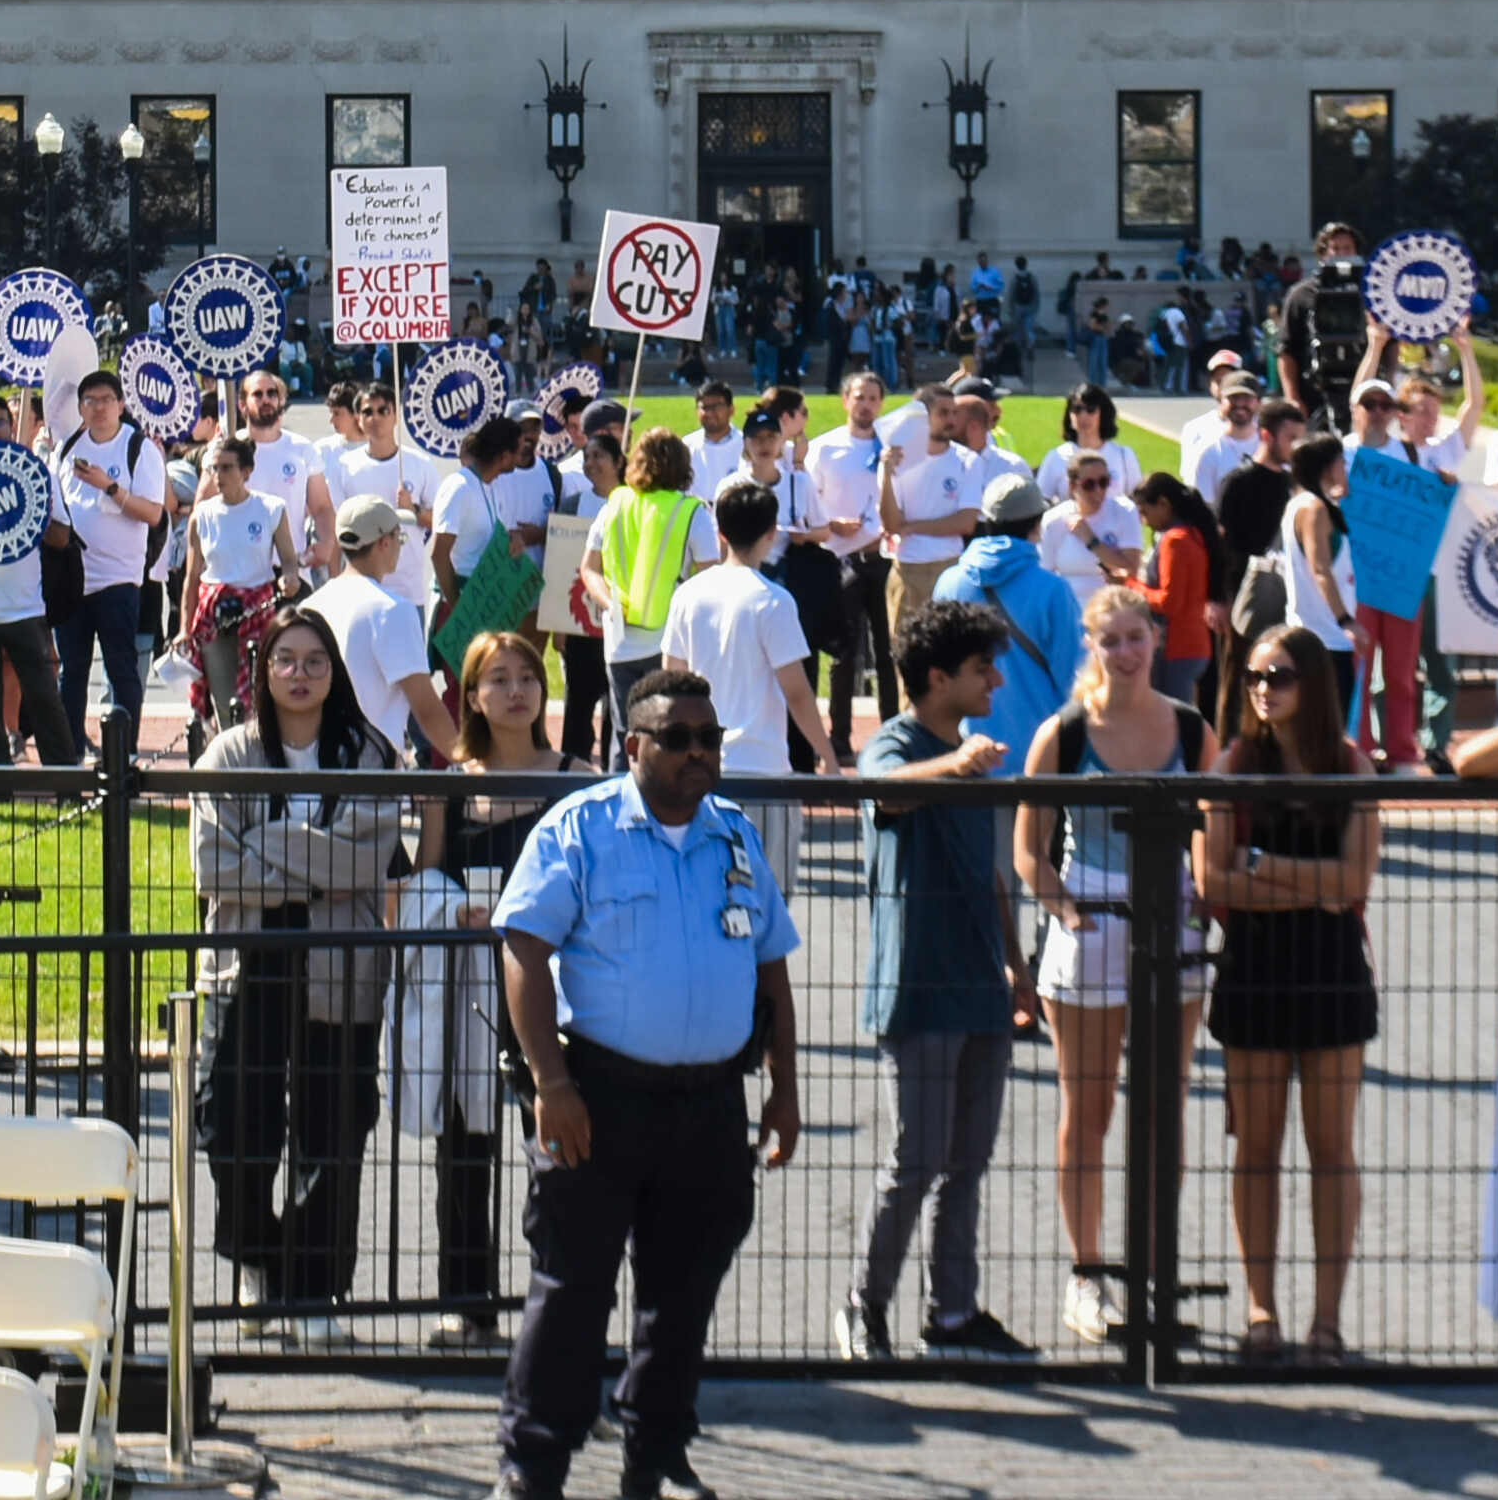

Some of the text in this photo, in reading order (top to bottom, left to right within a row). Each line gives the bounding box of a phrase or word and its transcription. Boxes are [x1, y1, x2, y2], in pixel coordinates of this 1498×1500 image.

[631, 240, 692, 278] PAY
[337, 262, 448, 294] EXCEPT
[341, 296, 359, 318] IF
[615, 280, 694, 318] CUTS
[11, 316, 59, 342] UAW
[198, 303, 247, 334] UAW
[336, 319, 452, 342] @COLUMBIA
[137, 371, 174, 406] UAW
[435, 380, 480, 421] UAW
